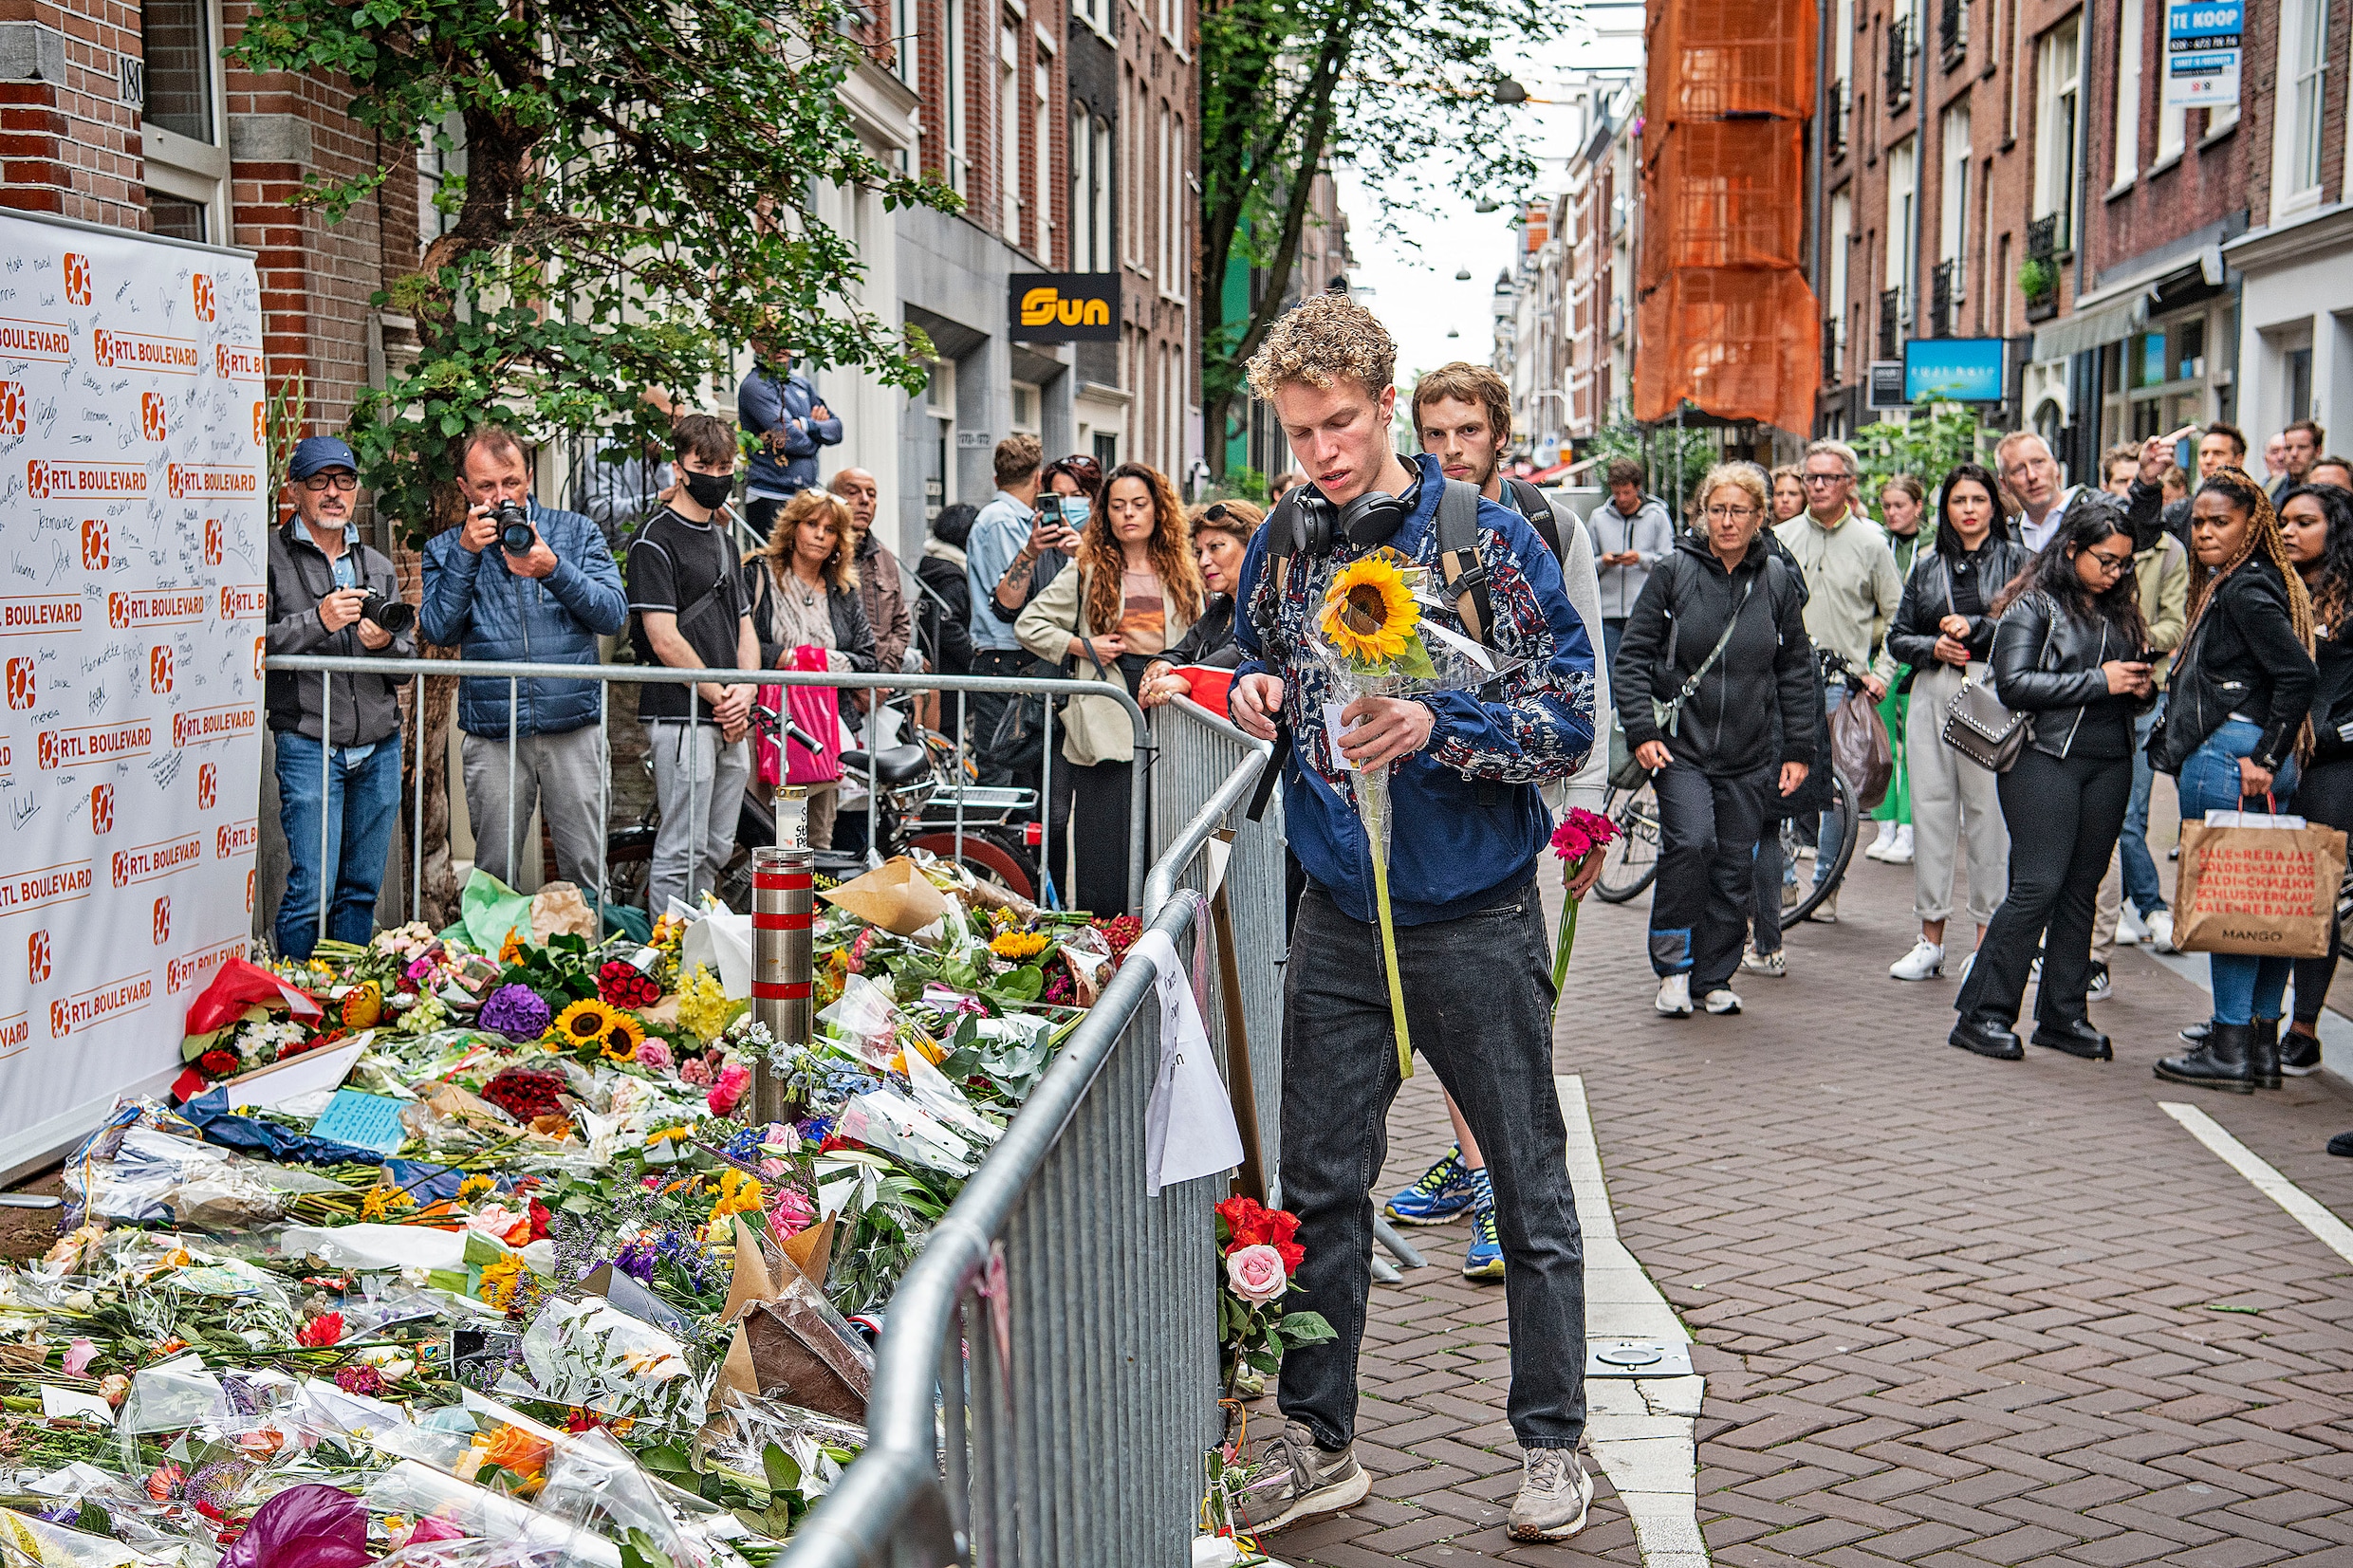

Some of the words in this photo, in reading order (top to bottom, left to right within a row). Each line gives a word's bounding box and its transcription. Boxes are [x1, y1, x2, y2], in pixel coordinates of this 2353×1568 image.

[2171, 12, 2188, 29] TE
[2193, 9, 2238, 28] KOOP
[120, 57, 144, 103] 180
[1021, 287, 1110, 326] Sun
[0, 327, 69, 354] OULEVARD
[115, 340, 136, 361] RTL
[138, 342, 197, 367] BOULEVARD
[231, 353, 251, 374] RTL
[51, 470, 76, 490] RTL
[79, 470, 147, 490] BOULEVARD
[184, 471, 202, 490] RTL
[204, 472, 256, 492] BOULEVARD
[5, 602, 82, 626] BOULEVARD
[131, 600, 149, 618] RTL
[152, 596, 204, 618] BOULEVARD
[236, 593, 255, 611] RTL
[187, 718, 201, 737] RTL
[203, 710, 255, 734] BOULEVARD
[61, 736, 85, 758] RTL
[89, 727, 152, 754] BOULEVARD
[232, 829, 249, 848] RTL
[130, 855, 150, 876] RTL
[153, 839, 200, 871] BOULEVARD
[21, 868, 92, 902] BOULEVARD
[2222, 930, 2283, 943] MANGO
[71, 1001, 92, 1024] RTL
[94, 979, 152, 1016] BOULEVARD
